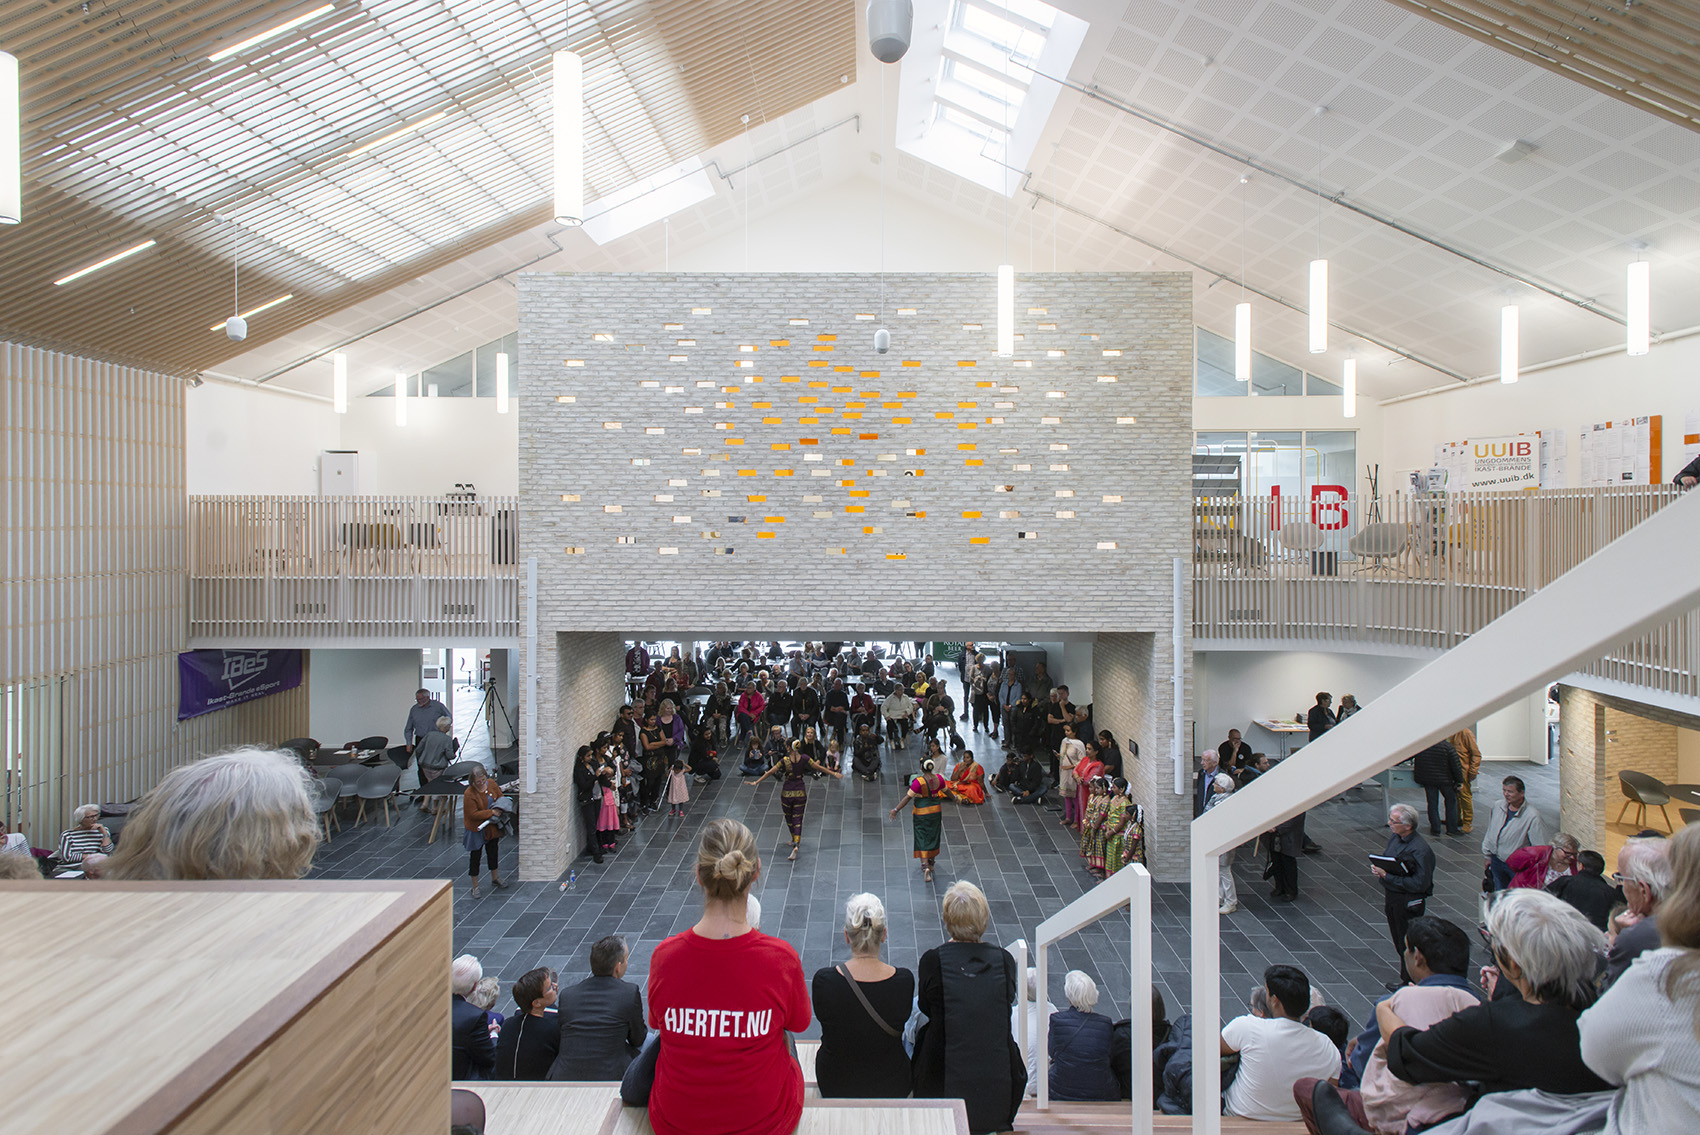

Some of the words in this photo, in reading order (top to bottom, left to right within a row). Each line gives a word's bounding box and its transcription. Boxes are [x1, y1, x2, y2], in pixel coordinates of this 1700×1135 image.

[1474, 442, 1531, 458] UUIB
[1474, 464, 1532, 472] IKAST-BRANDE
[1471, 472, 1535, 487] www.uuib.dk
[664, 1007, 772, 1038] HJERTET.NU
